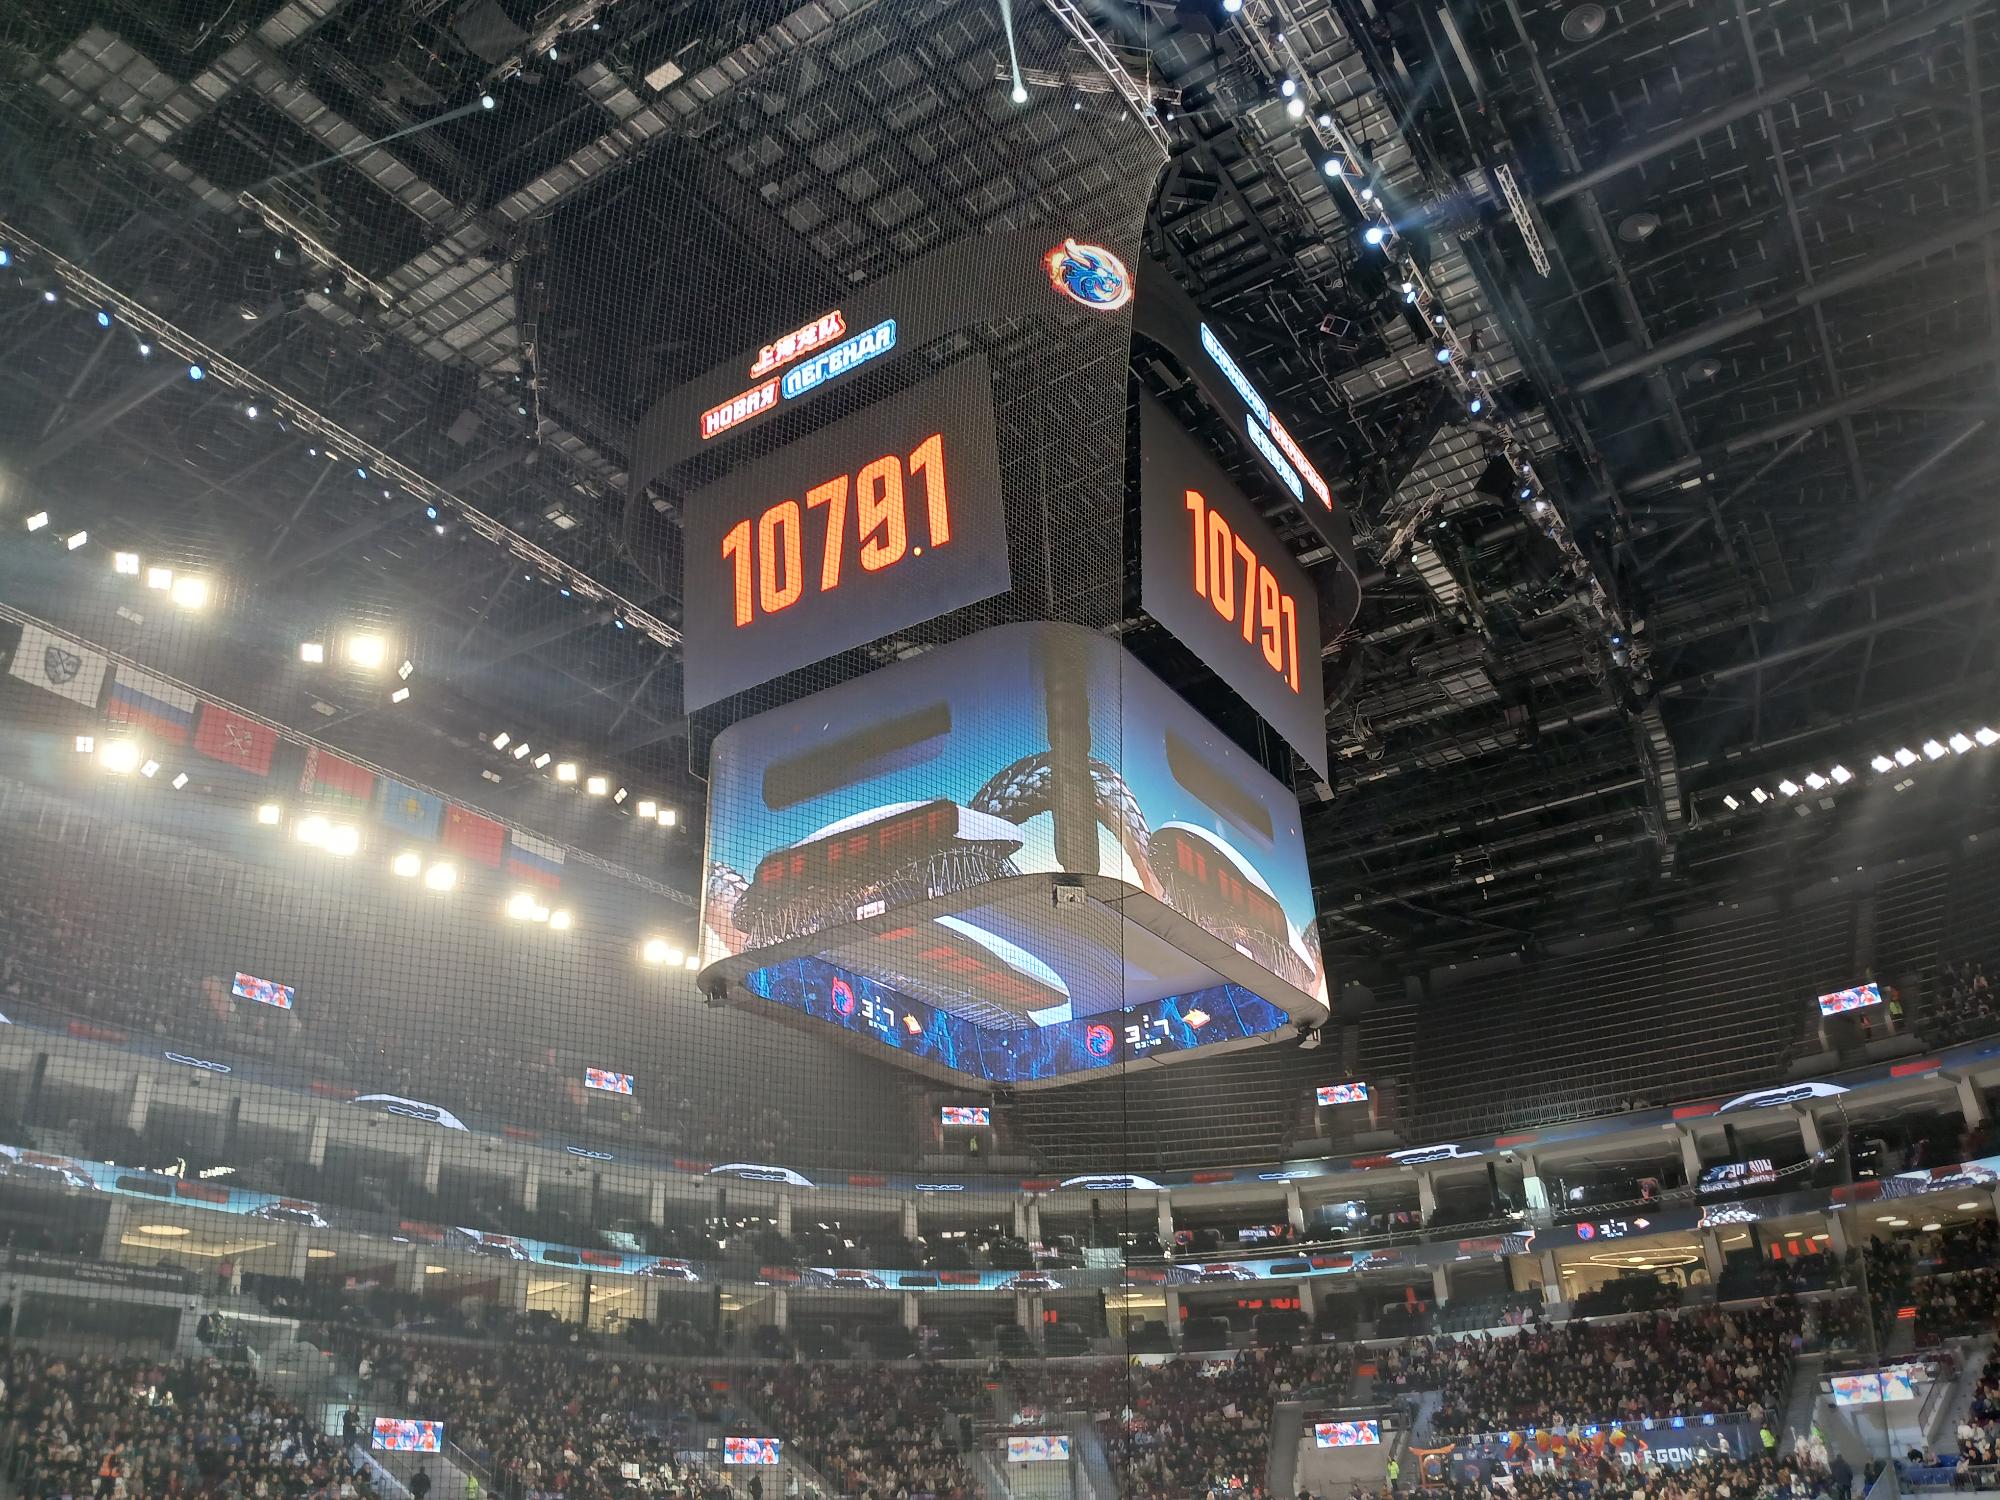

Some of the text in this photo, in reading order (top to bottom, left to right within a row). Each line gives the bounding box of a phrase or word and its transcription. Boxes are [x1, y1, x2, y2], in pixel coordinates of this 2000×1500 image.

[705, 323, 892, 434] НОВАЯ ЛЕГЕНДА
[1125, 1018, 1170, 1044] 3:7
